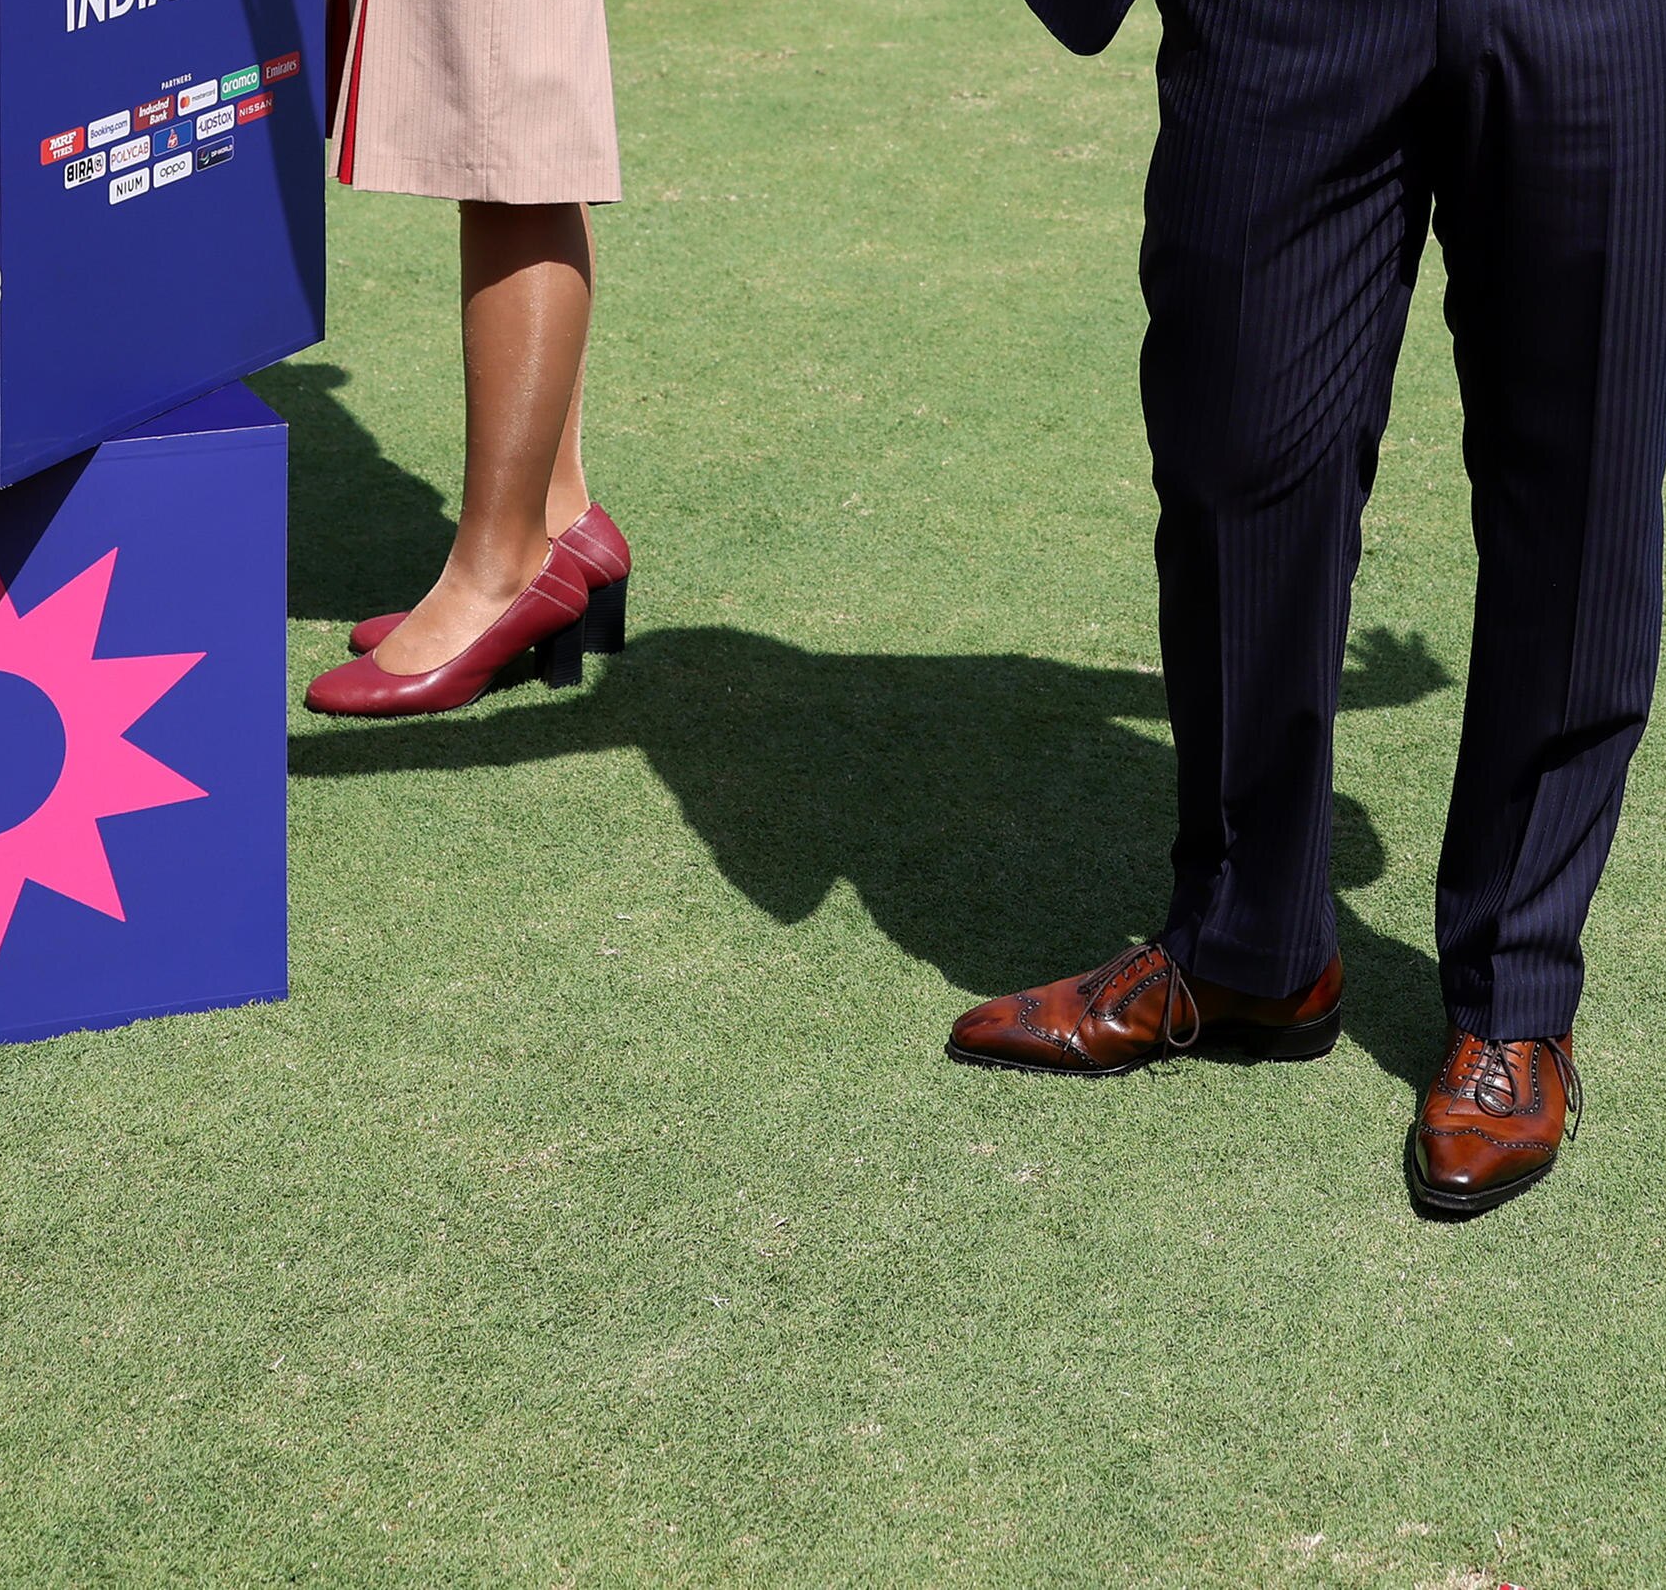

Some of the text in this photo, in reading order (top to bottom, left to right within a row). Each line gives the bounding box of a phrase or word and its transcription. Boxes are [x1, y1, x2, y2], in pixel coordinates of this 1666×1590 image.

[266, 59, 297, 79] Emirates
[161, 73, 192, 90] PARTNERS
[222, 72, 258, 93] aramco
[149, 110, 168, 125] Bank
[239, 99, 273, 116] NISSAN
[90, 119, 128, 140] Booking.com
[199, 110, 233, 134] upstox
[49, 131, 77, 150] MRF
[111, 142, 149, 163] POLYCAB
[67, 158, 94, 182] BIRA
[159, 160, 186, 180] oppo
[116, 176, 143, 196] NIUM
